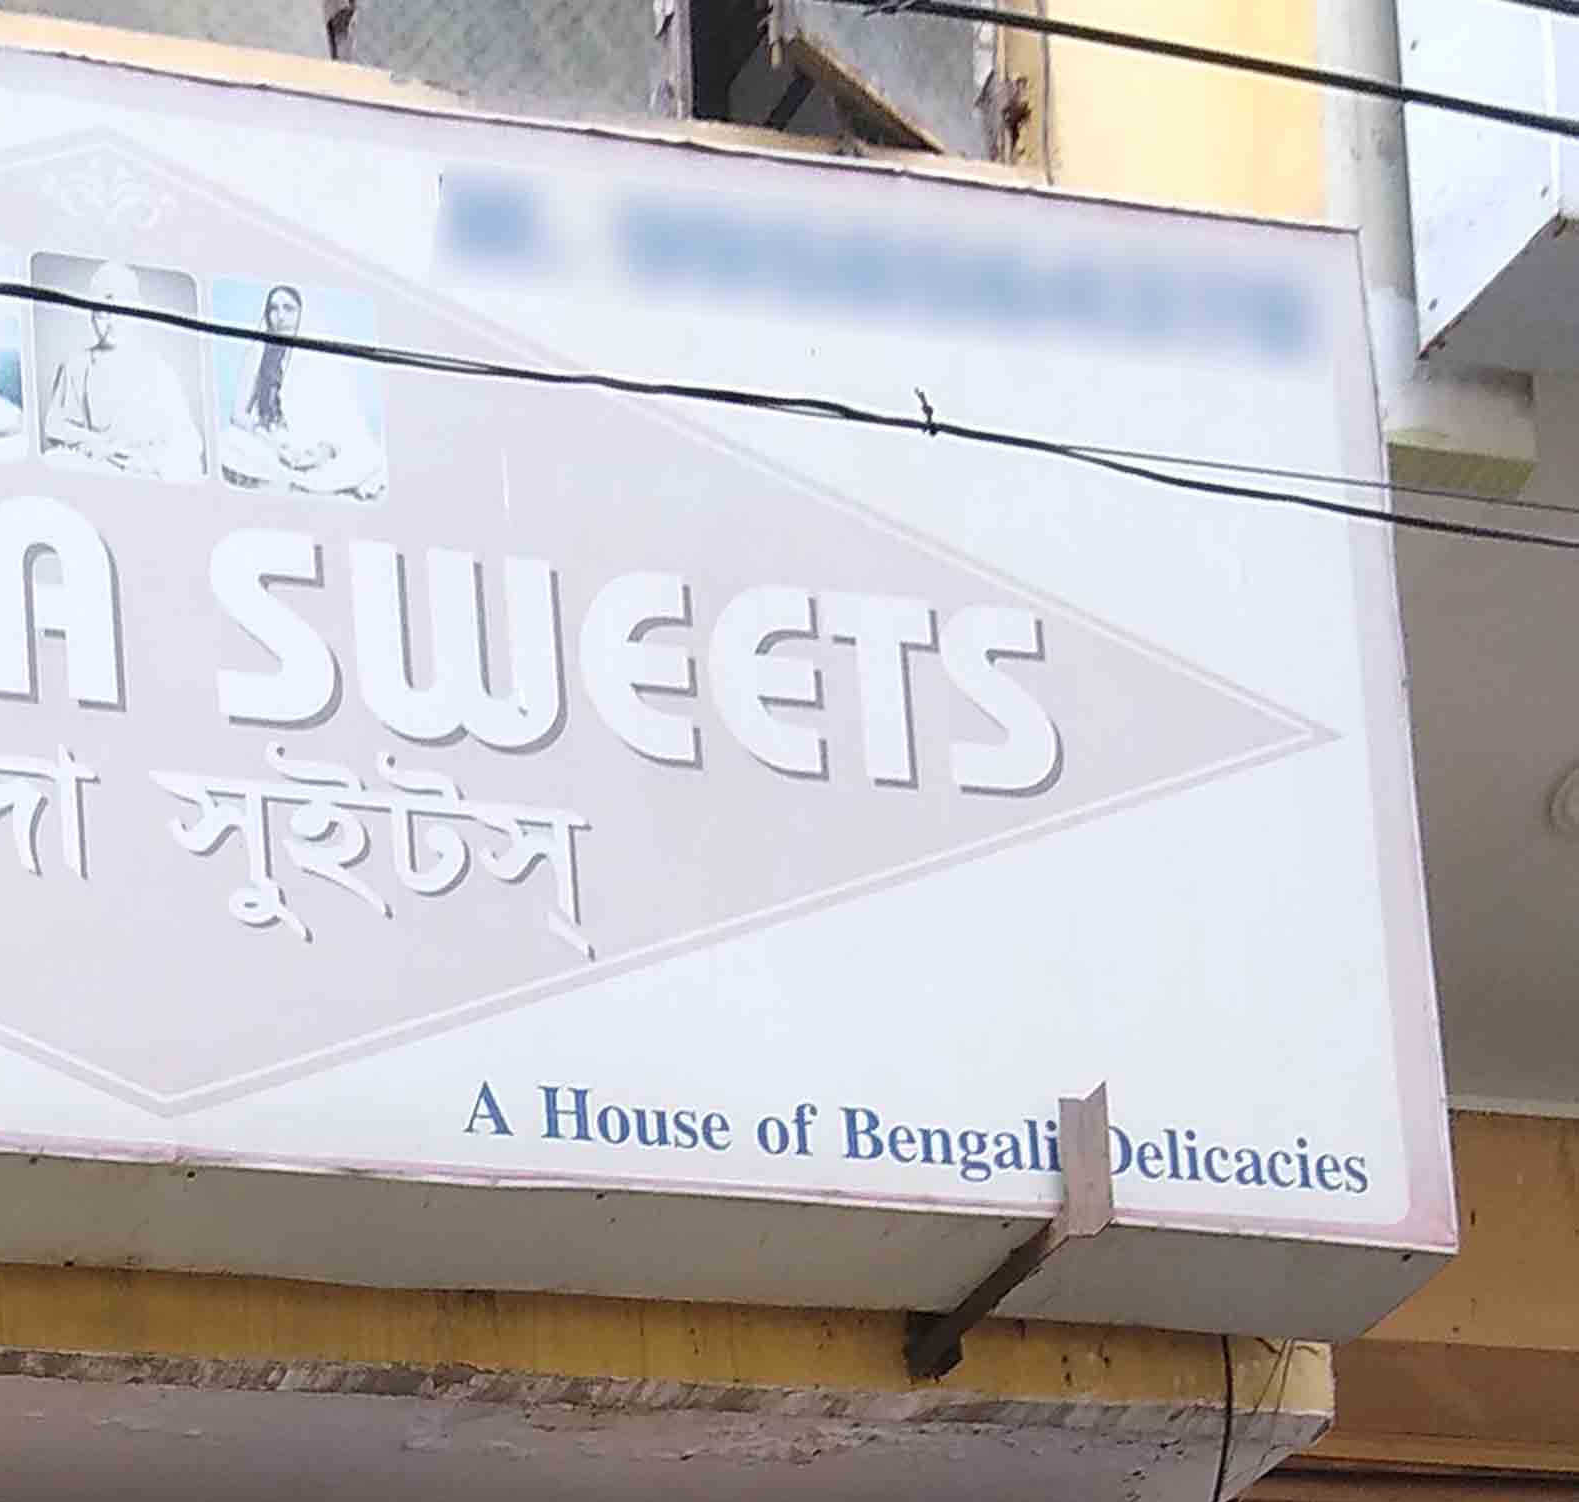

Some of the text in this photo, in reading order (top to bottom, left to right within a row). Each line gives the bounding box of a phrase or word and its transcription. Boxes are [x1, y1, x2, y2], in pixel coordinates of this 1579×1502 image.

[210, 527, 1063, 797] SWEETS
[463, 1081, 513, 1138] A
[537, 1083, 731, 1152] House
[755, 1102, 819, 1159] of
[841, 1105, 1062, 1183] Bengali
